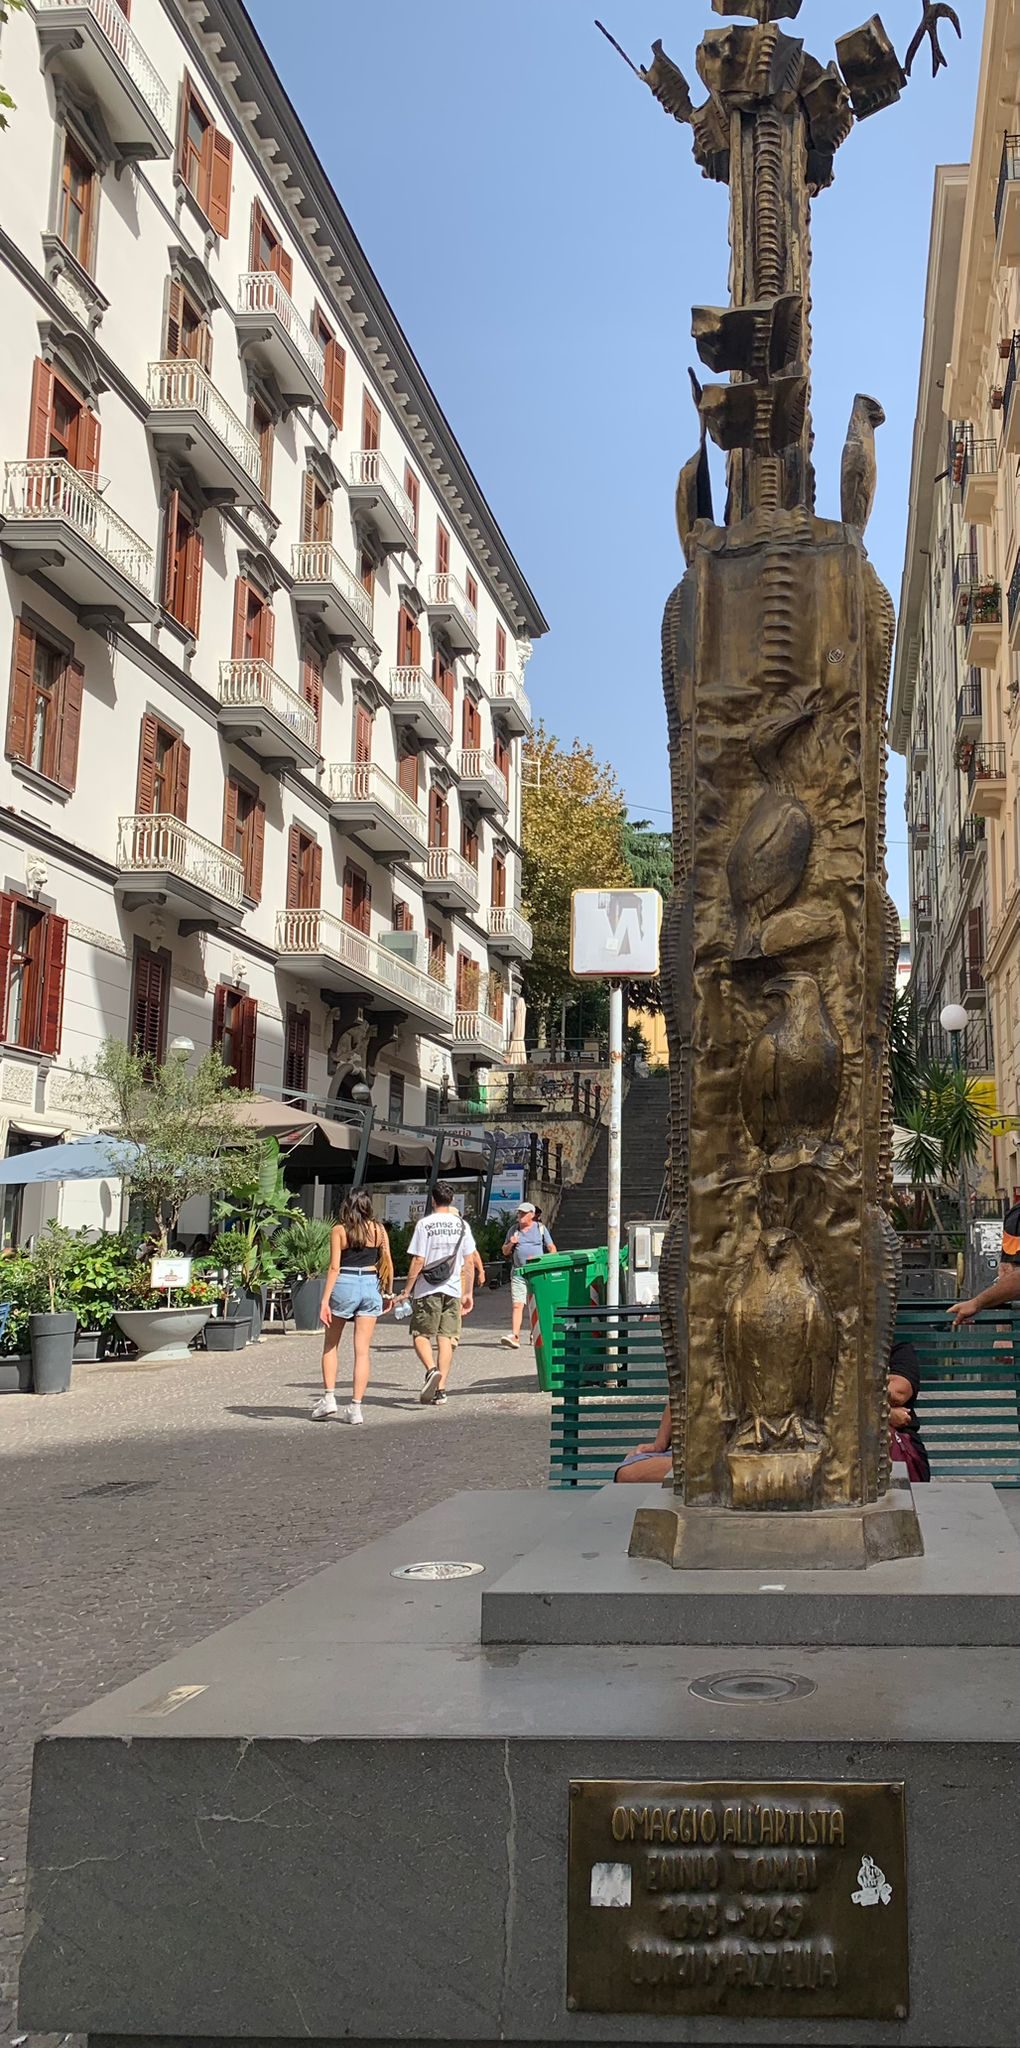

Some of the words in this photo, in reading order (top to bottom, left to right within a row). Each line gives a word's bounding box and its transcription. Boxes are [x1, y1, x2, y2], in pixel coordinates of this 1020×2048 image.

[611, 1805, 717, 1842] OMAGGIO
[722, 1804, 845, 1846] ALL'ARTISTA
[646, 1853, 719, 1891] ENNIO
